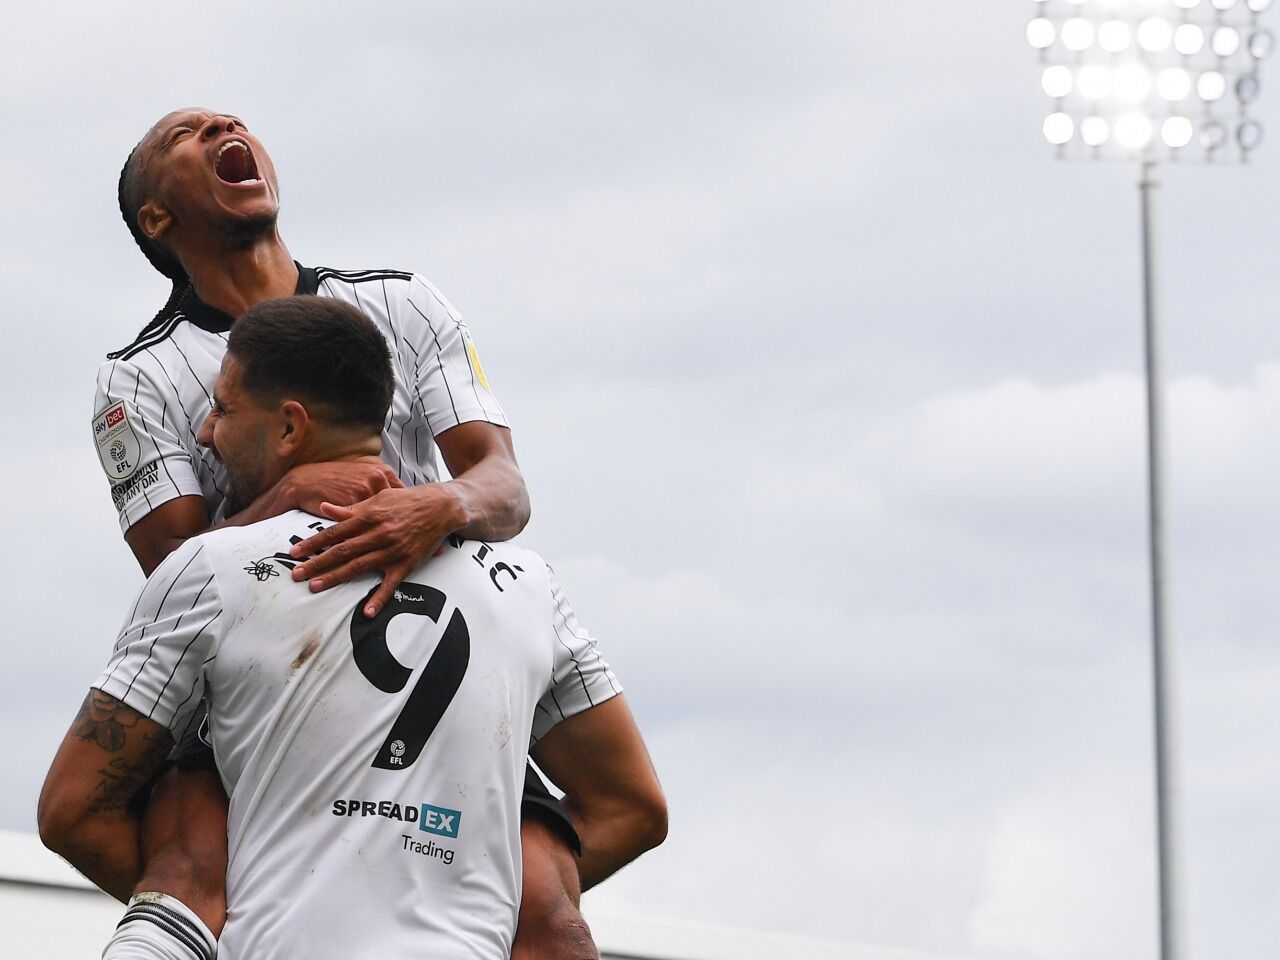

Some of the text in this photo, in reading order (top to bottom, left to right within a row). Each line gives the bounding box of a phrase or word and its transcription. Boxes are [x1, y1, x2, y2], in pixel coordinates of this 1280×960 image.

[95, 420, 106, 435] sky
[107, 408, 123, 424] bet
[116, 460, 132, 474] EFL
[126, 483, 142, 503] ANY
[141, 470, 159, 489] DAY
[350, 582, 471, 770] 9
[390, 756, 403, 765] EFL
[402, 835, 455, 865] Trading
